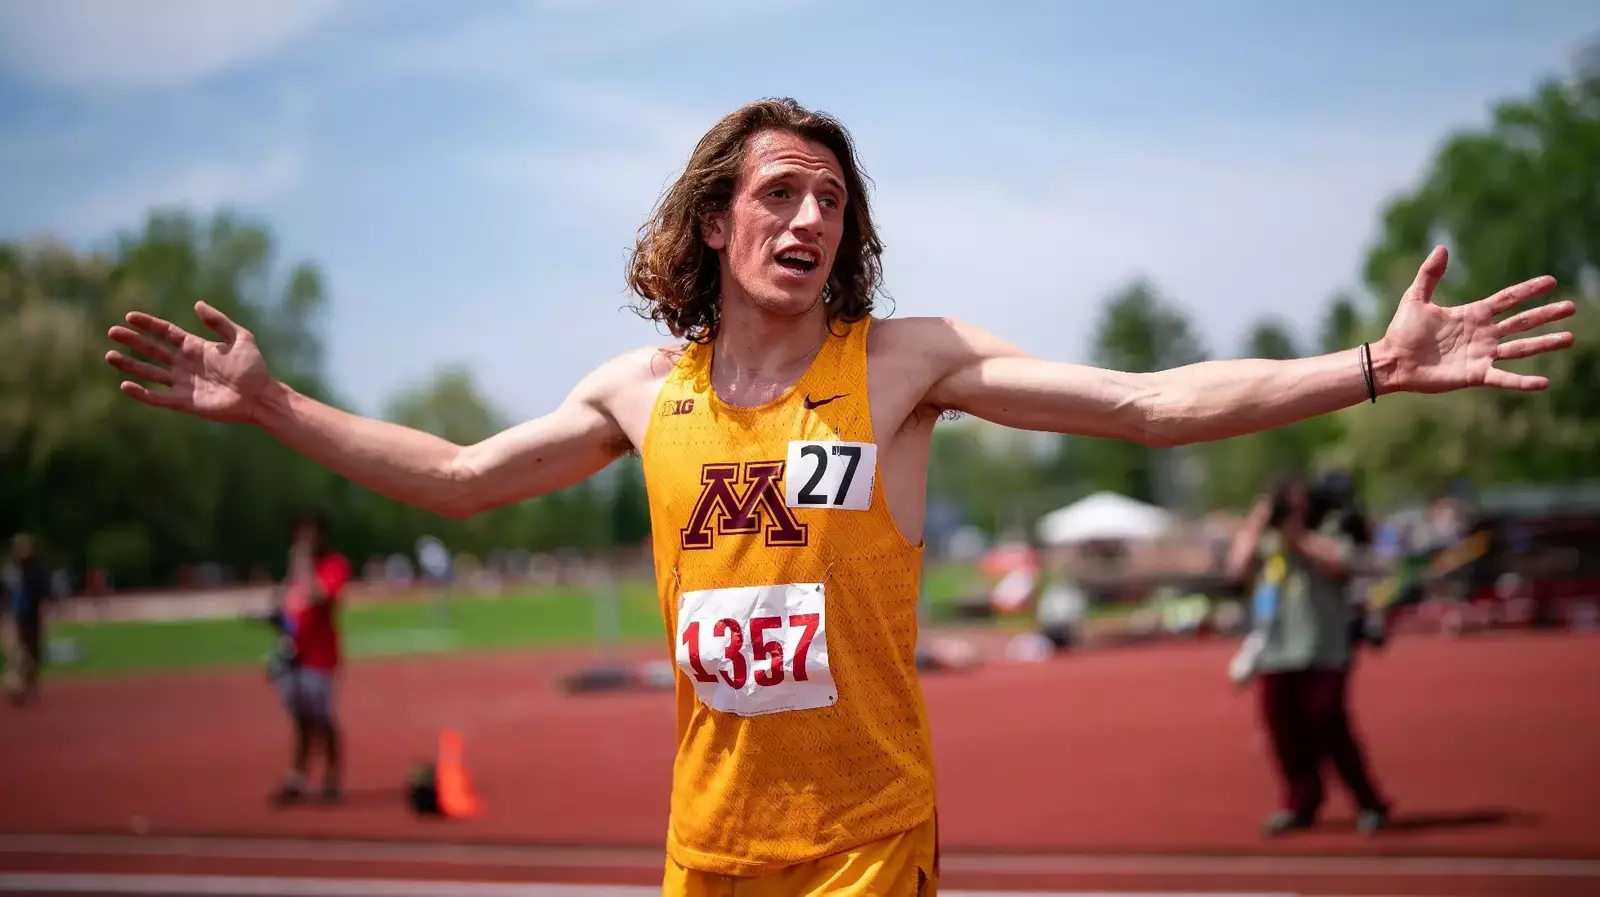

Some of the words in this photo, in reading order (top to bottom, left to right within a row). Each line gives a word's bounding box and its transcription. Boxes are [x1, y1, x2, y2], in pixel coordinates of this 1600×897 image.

[680, 461, 808, 550] M
[797, 445, 861, 505] 27
[682, 613, 820, 690] 1357
